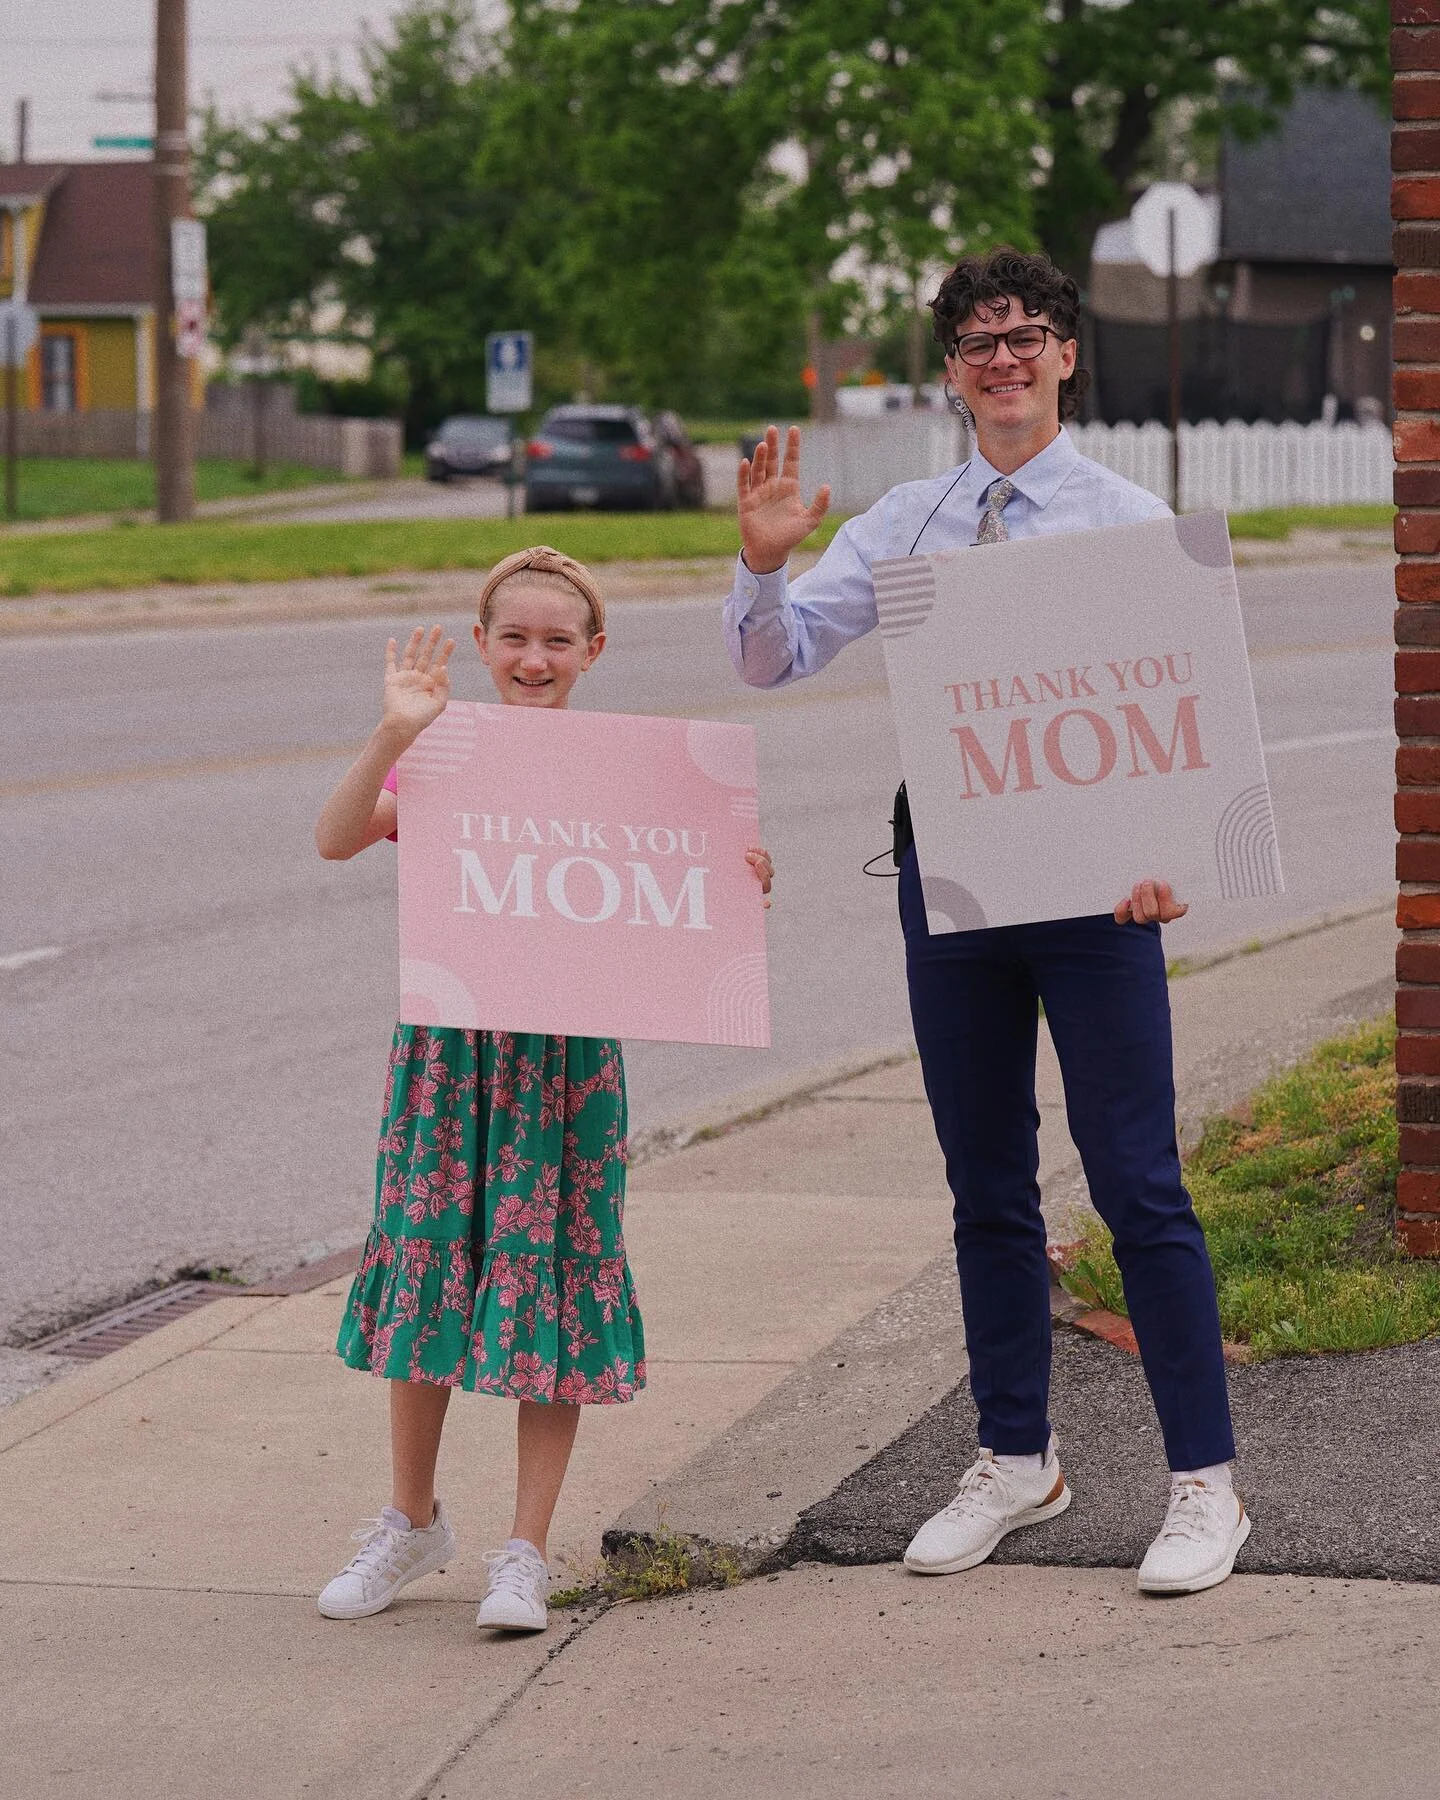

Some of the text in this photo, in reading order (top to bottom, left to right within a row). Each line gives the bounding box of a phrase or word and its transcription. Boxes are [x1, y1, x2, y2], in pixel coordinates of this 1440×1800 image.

[944, 652, 1192, 714] THANK YOU
[949, 694, 1211, 800] MOM
[453, 811, 710, 858] THANK YOU
[453, 848, 713, 931] MOM
